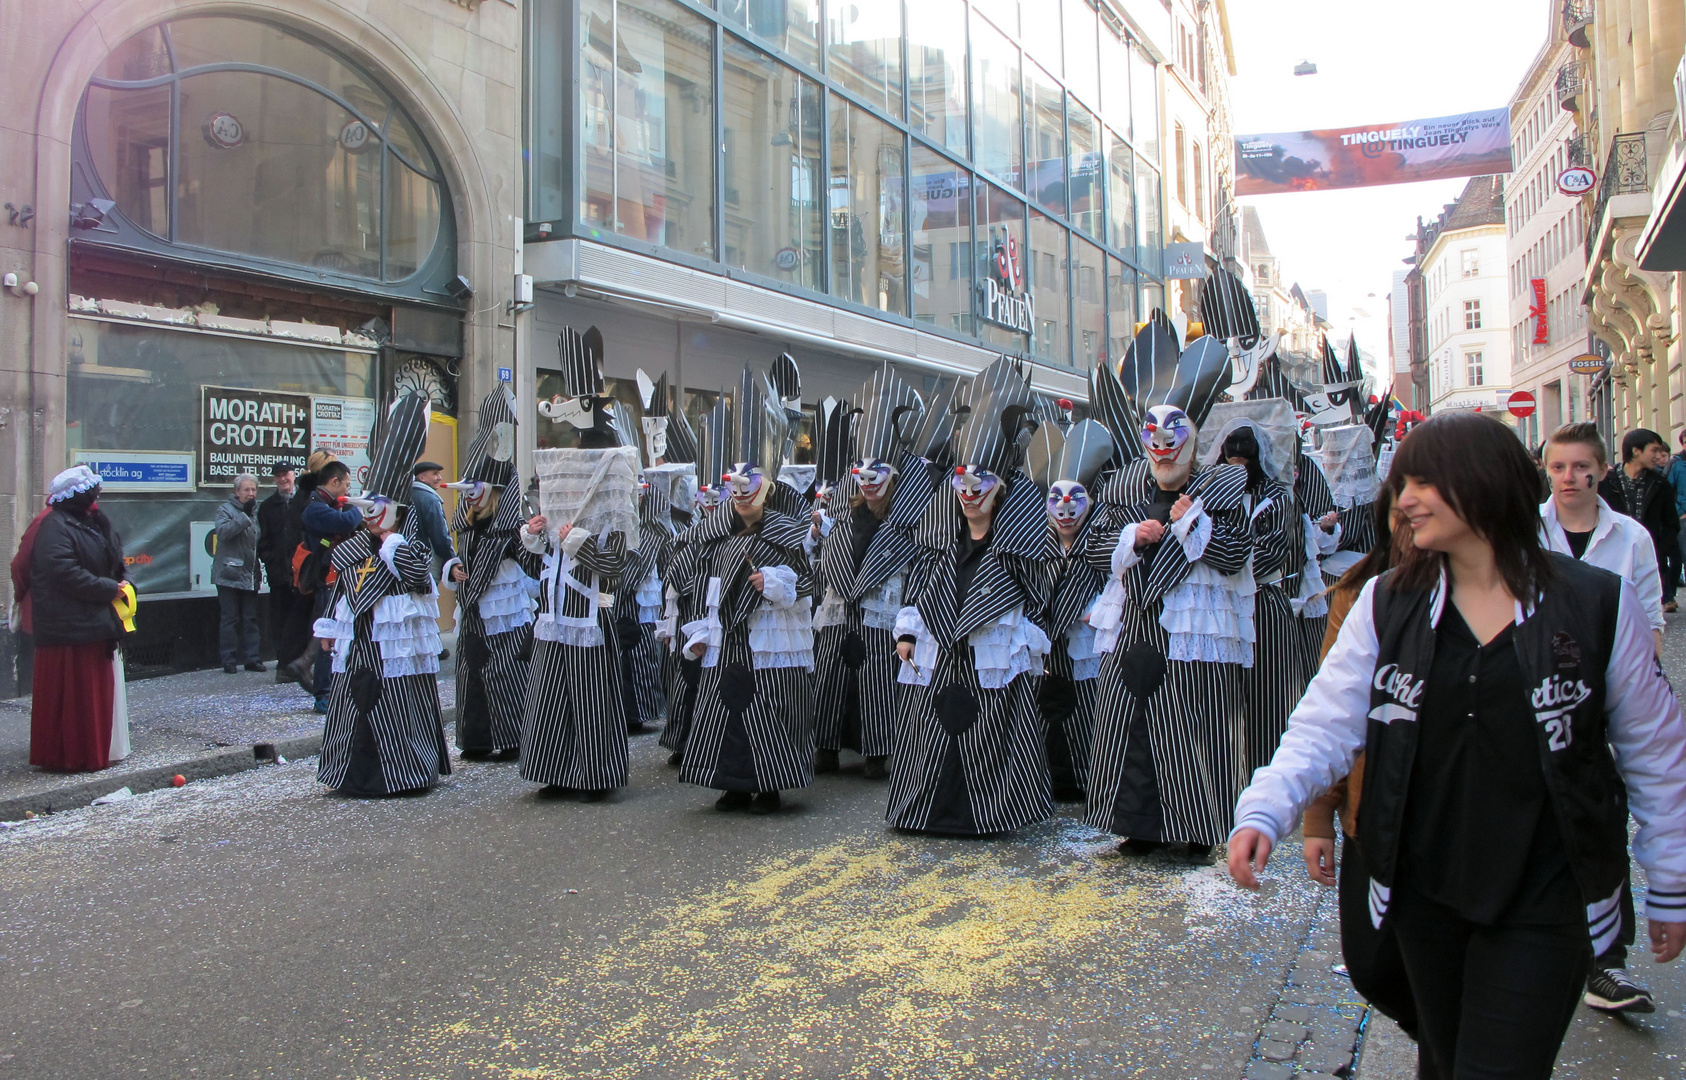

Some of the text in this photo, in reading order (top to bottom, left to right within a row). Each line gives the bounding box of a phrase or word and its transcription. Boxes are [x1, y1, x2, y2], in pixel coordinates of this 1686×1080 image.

[1340, 125, 1420, 146] TINGUELY
[1387, 131, 1469, 151] TINGUELY
[1563, 173, 1591, 188] C&A
[986, 276, 1035, 335] PFAUEN
[1571, 360, 1604, 368] FOSSIL
[210, 398, 306, 425] MORATH+
[210, 422, 306, 448] CROTTAZ
[210, 452, 306, 466] BAUUNTERNEHMUNG
[131, 470, 143, 480] ag
[210, 465, 240, 477] BASEL
[243, 466, 260, 477] TEL
[135, 553, 154, 567] city
